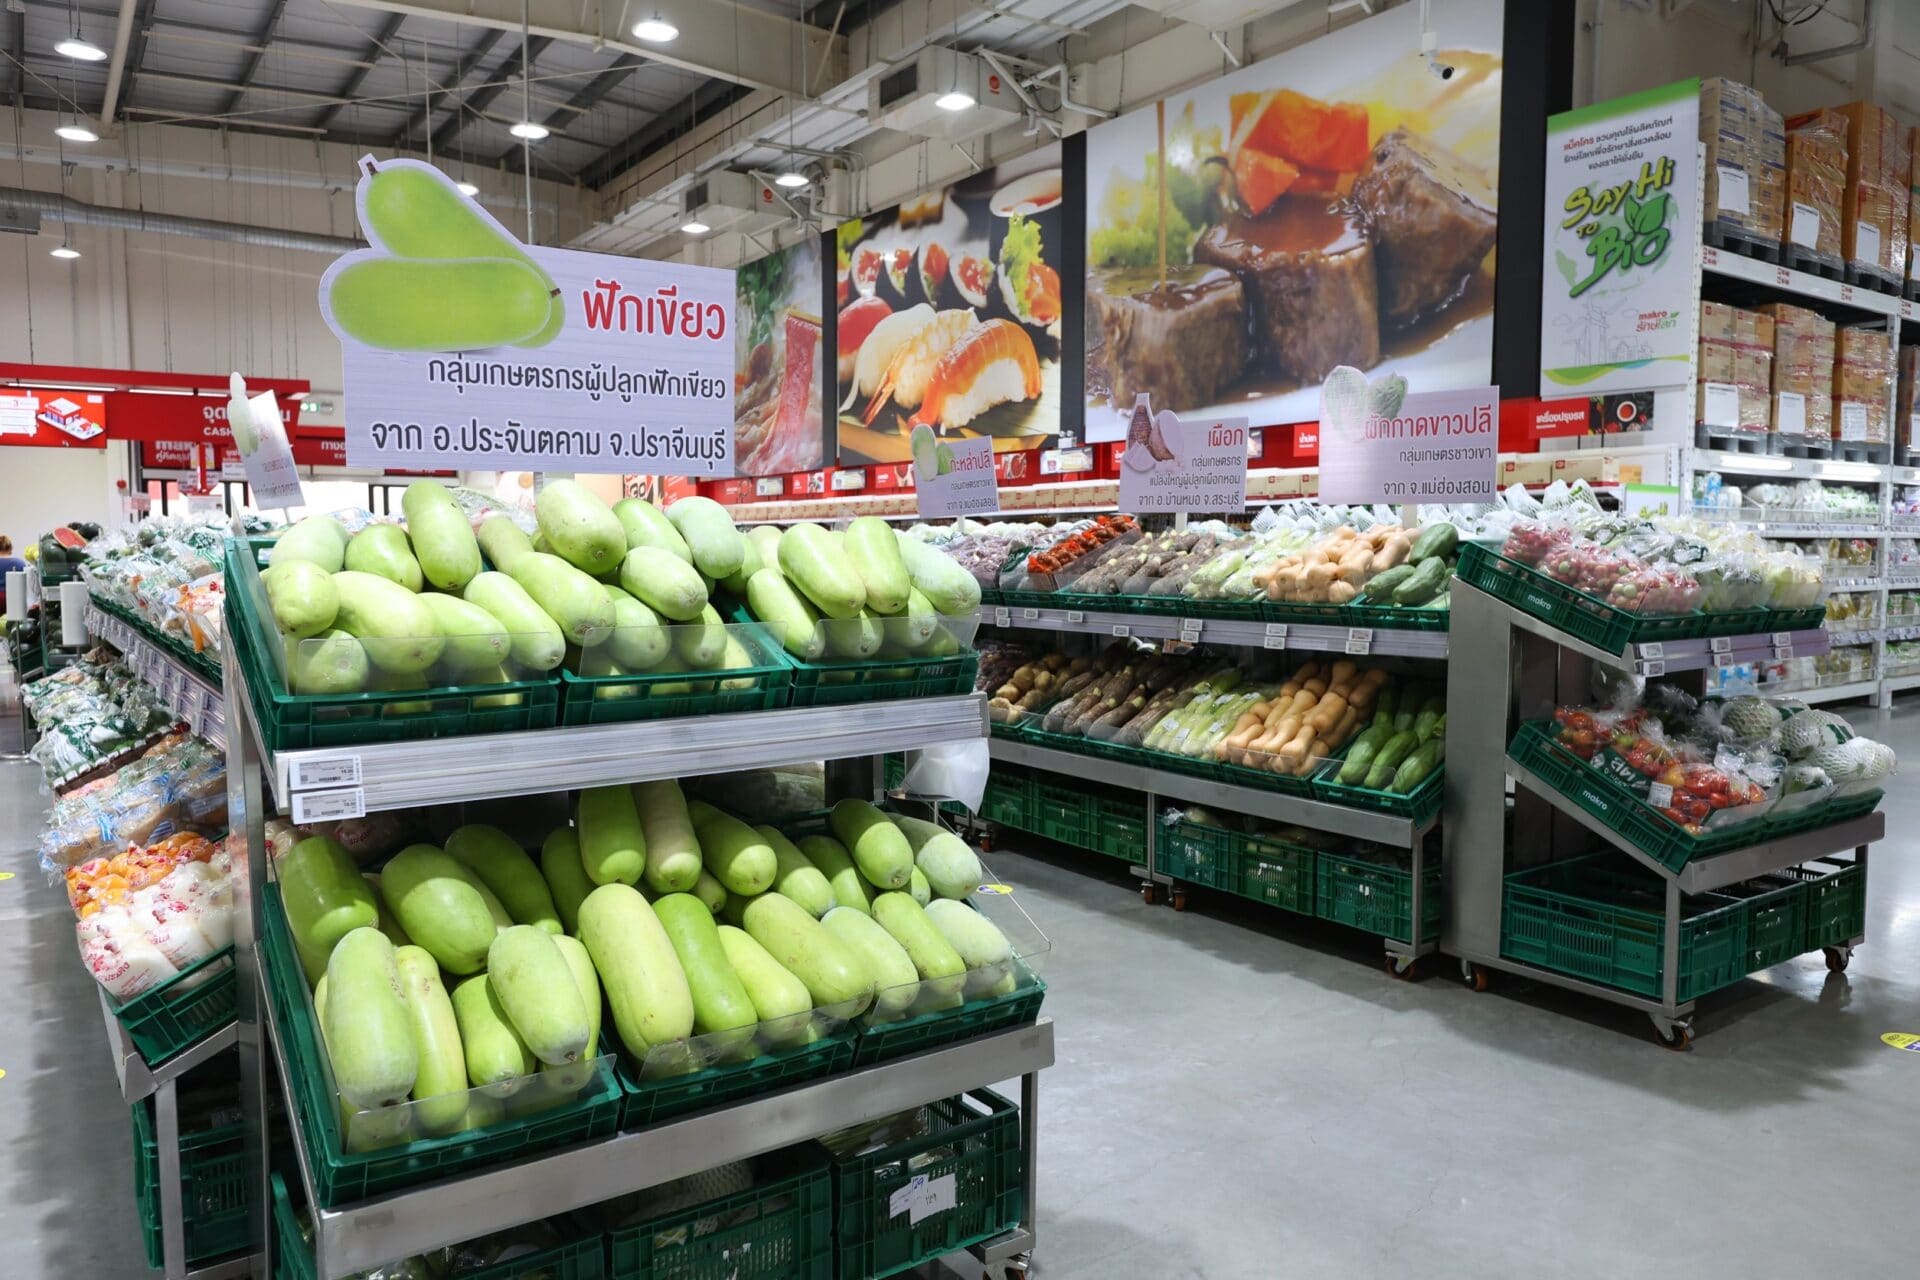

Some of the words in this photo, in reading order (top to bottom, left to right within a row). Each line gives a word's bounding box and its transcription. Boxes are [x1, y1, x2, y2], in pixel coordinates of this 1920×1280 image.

[1637, 156, 1676, 199] Hi
[582, 279, 726, 340] ฟักเขียว
[428, 352, 726, 403] กลุ่มเกษตรกรผู้ปลูกฟักเขียว
[371, 422, 422, 451] จาก
[433, 419, 600, 457] อ.ประจันตคาม
[609, 426, 726, 471] จ.ปราจีนบุรี
[1208, 423, 1243, 447] เผือก
[1191, 454, 1241, 471] กลุ่มเกษตรกร
[1399, 446, 1491, 466] กลุ่มเกษตรชาวเขา
[1383, 481, 1405, 495] จาก
[1410, 477, 1491, 495] จ.แม่ฮ่องสอน
[1138, 494, 1154, 506] จาก
[1527, 594, 1552, 610] makro
[1582, 790, 1608, 811] makro
